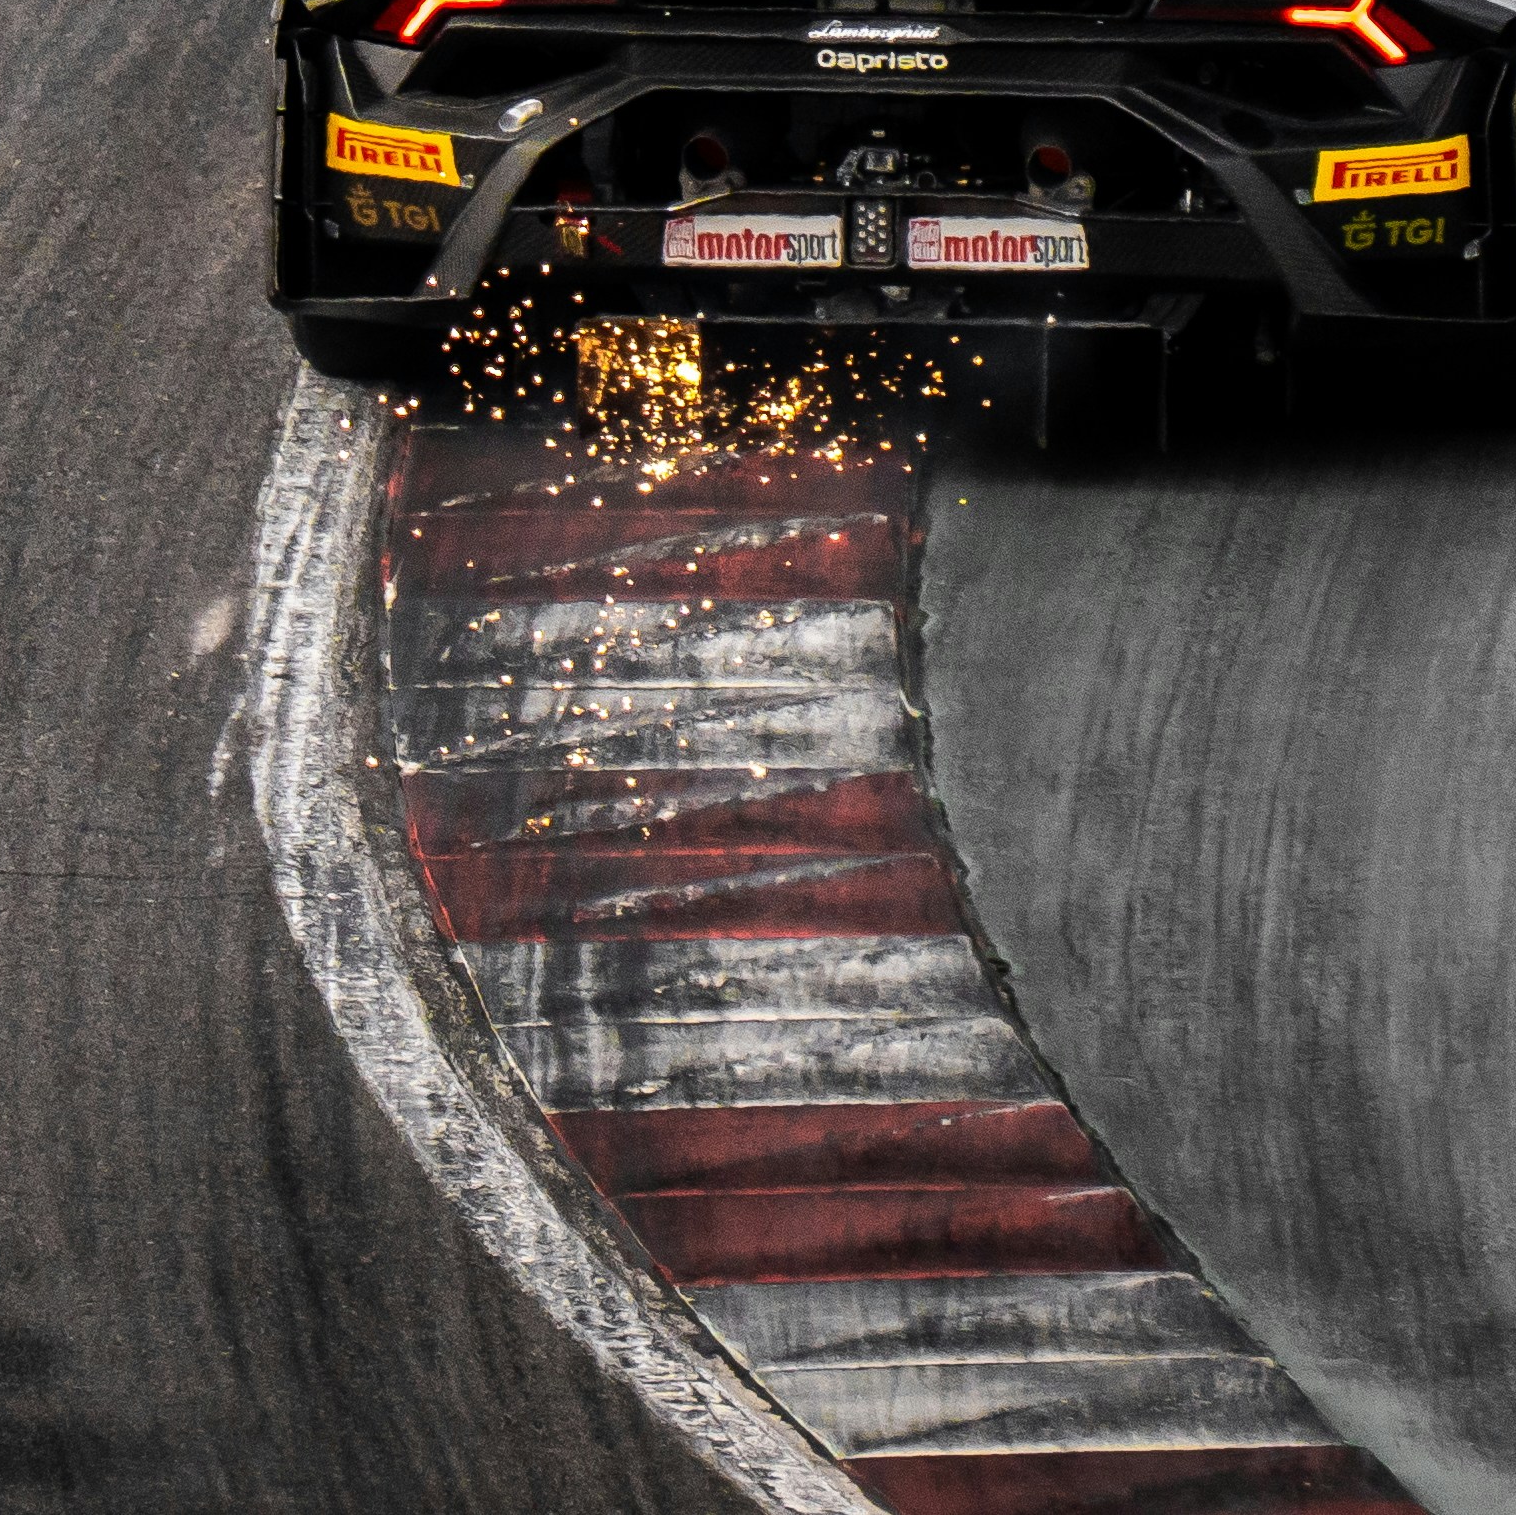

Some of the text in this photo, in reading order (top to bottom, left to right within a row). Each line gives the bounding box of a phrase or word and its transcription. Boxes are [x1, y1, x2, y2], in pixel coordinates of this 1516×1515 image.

[337, 127, 443, 173] PIRELLI
[1331, 149, 1459, 189] PIRELLI
[383, 200, 442, 233] TGI
[1384, 216, 1446, 247] TGI
